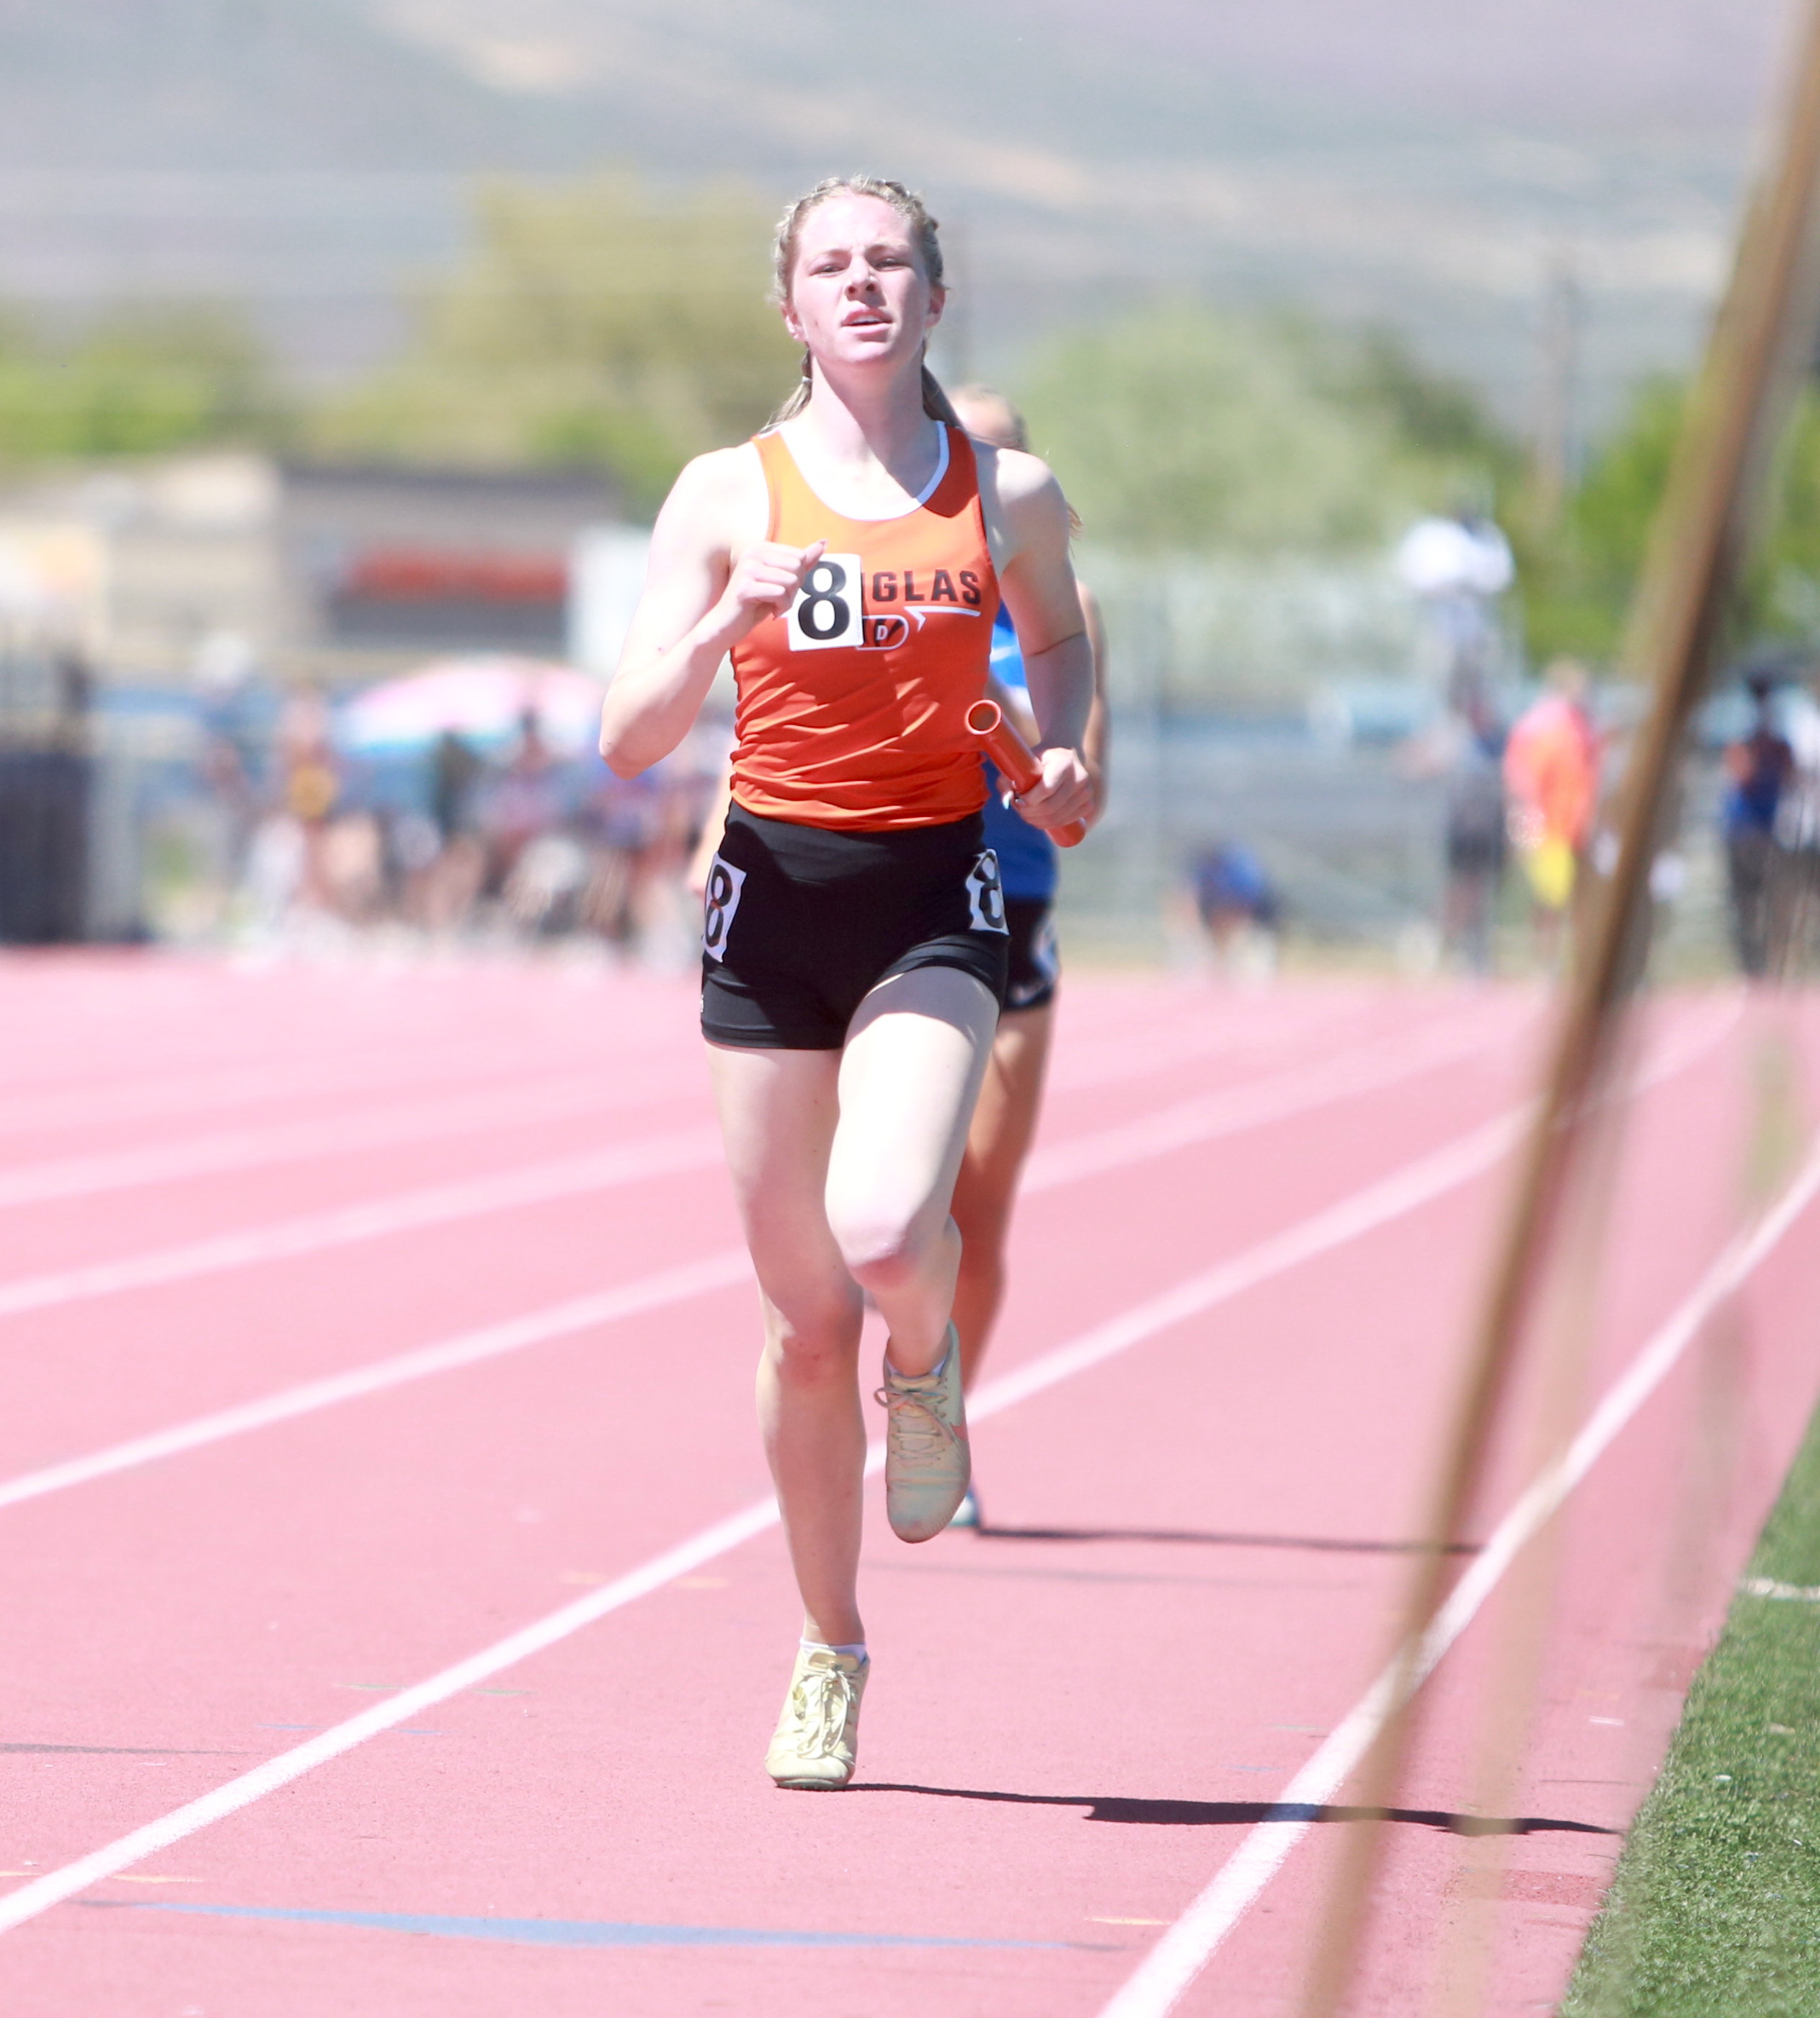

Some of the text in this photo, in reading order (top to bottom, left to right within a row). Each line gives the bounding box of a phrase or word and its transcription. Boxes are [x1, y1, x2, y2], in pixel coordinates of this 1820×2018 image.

[797, 560, 851, 640] 8
[861, 569, 981, 605] GLAS
[876, 625, 889, 641] D
[706, 864, 733, 947] 8
[974, 851, 1004, 929] 8
